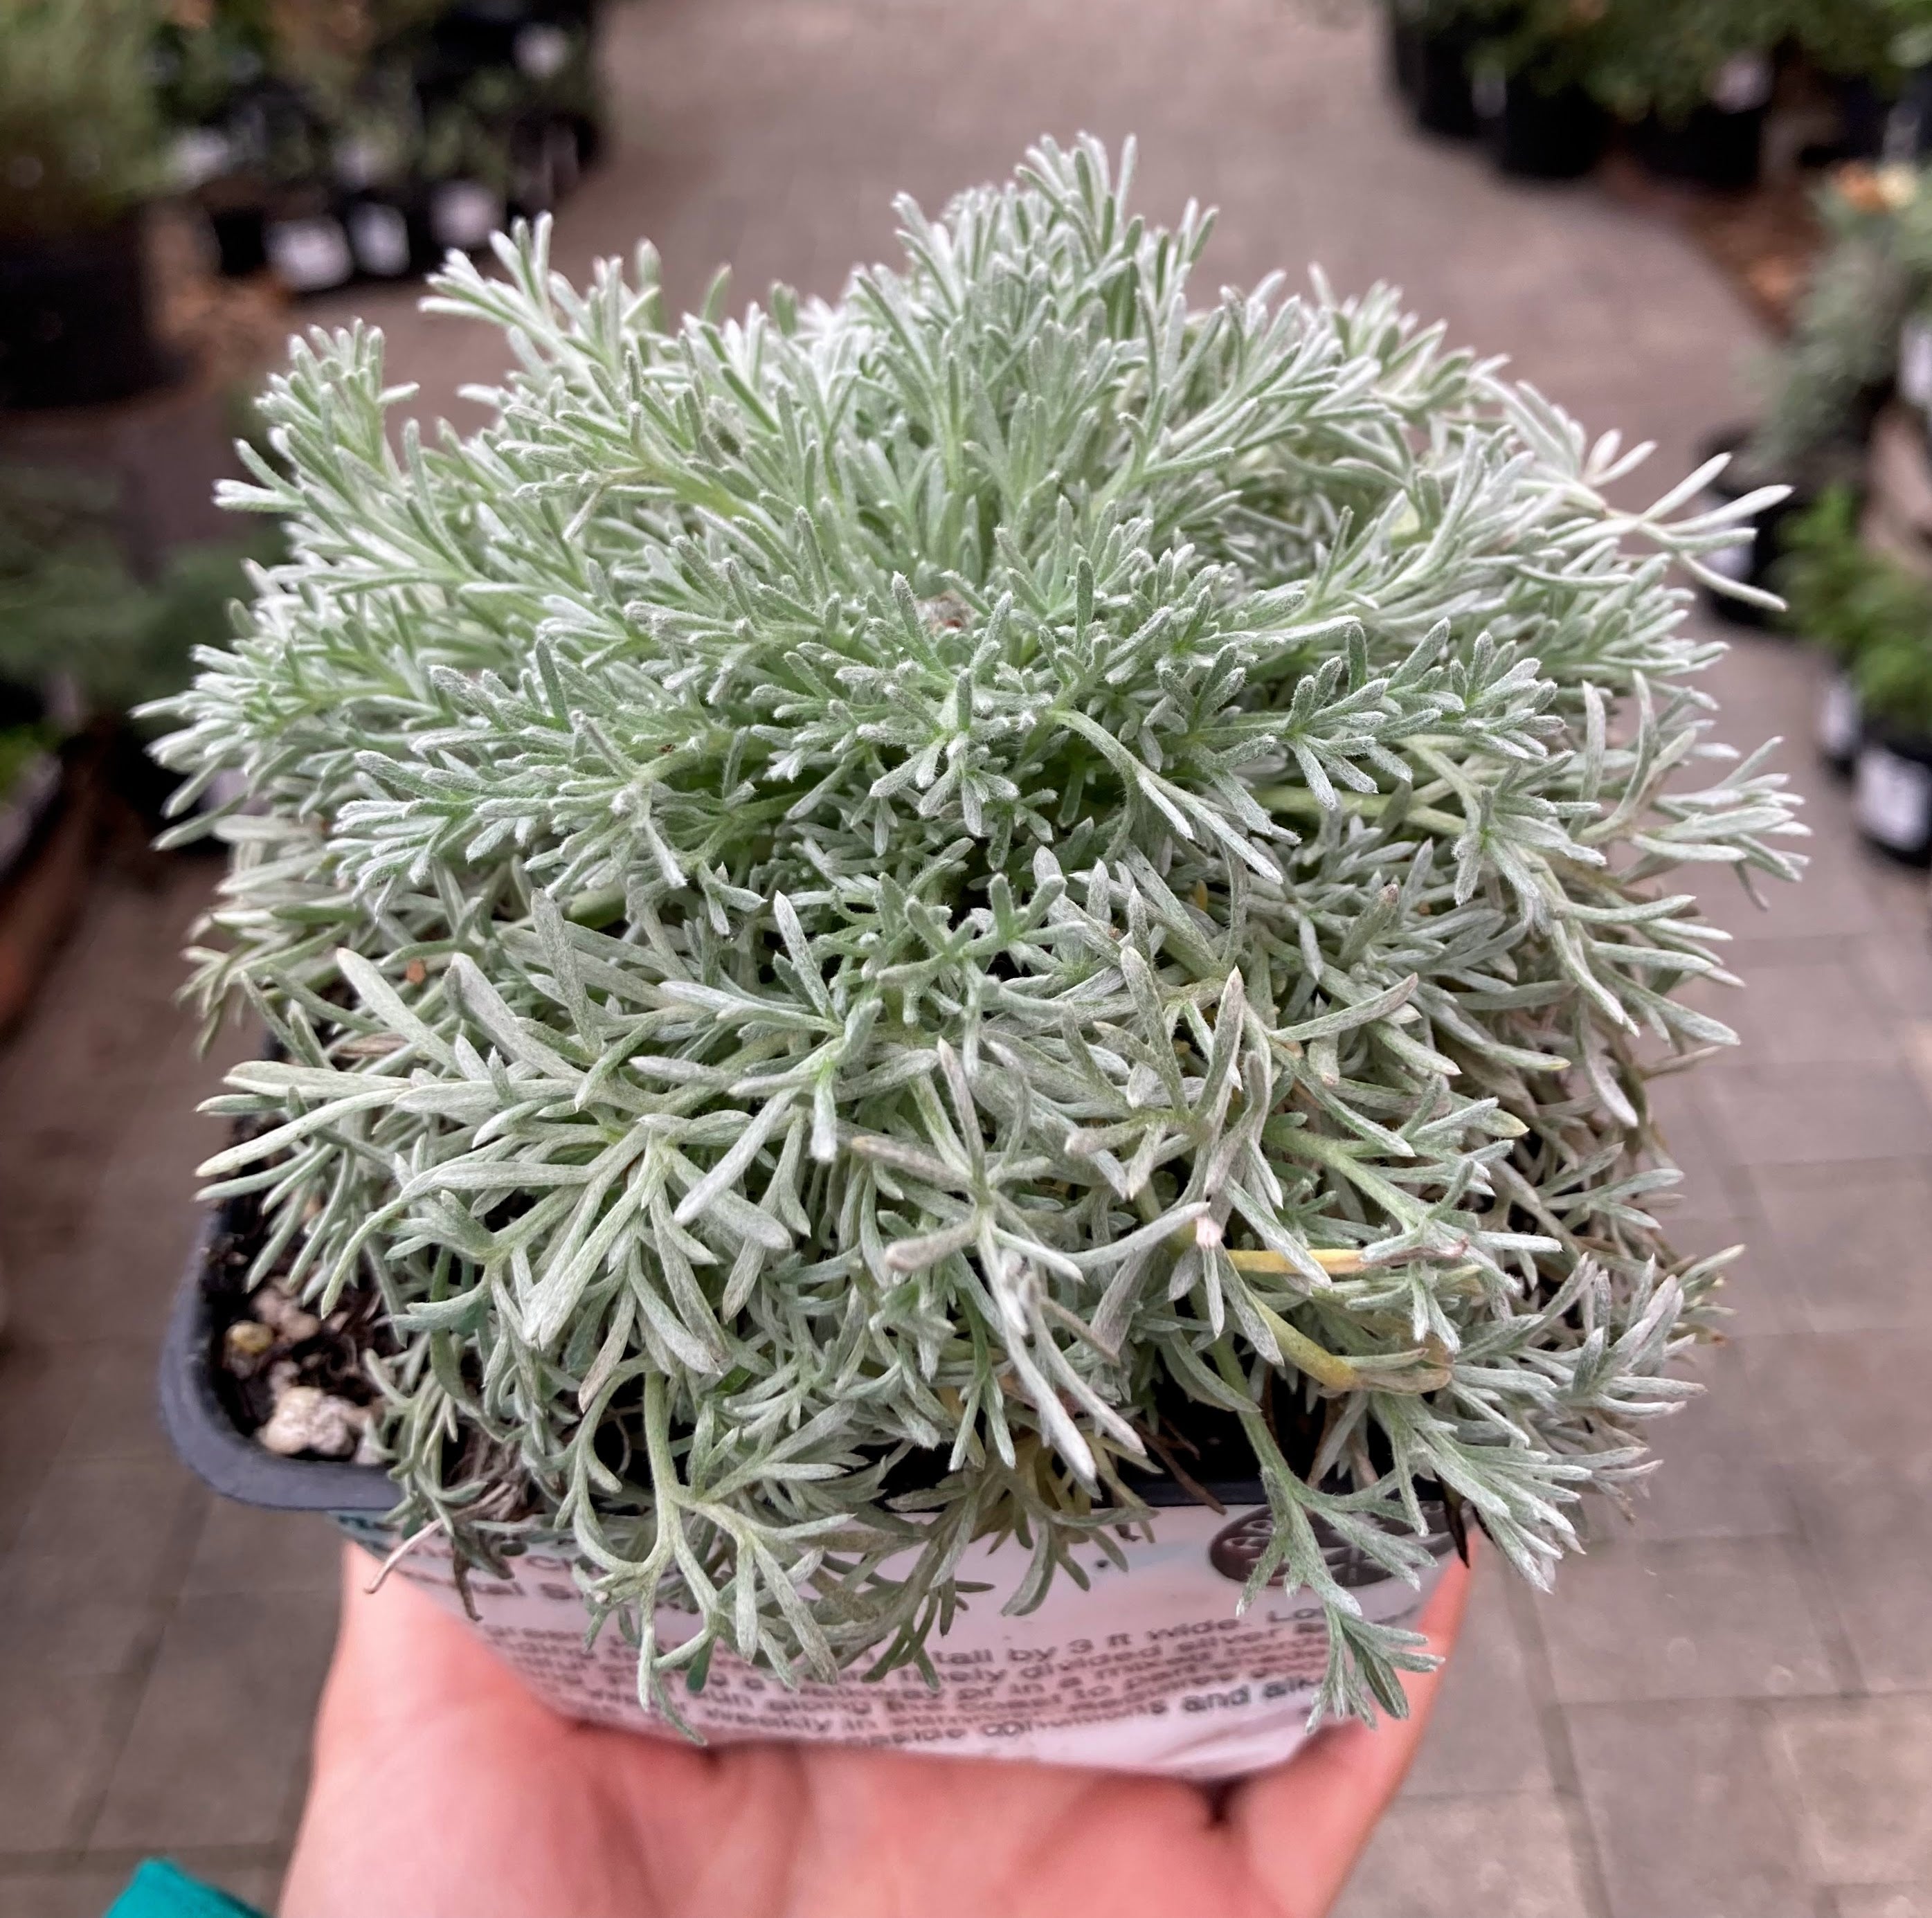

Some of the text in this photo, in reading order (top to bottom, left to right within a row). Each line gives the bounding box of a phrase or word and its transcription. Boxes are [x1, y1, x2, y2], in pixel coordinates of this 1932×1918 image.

[1008, 1646, 1057, 1662] by
[1069, 1638, 1094, 1654] 3
[1182, 1685, 1250, 1713] and
